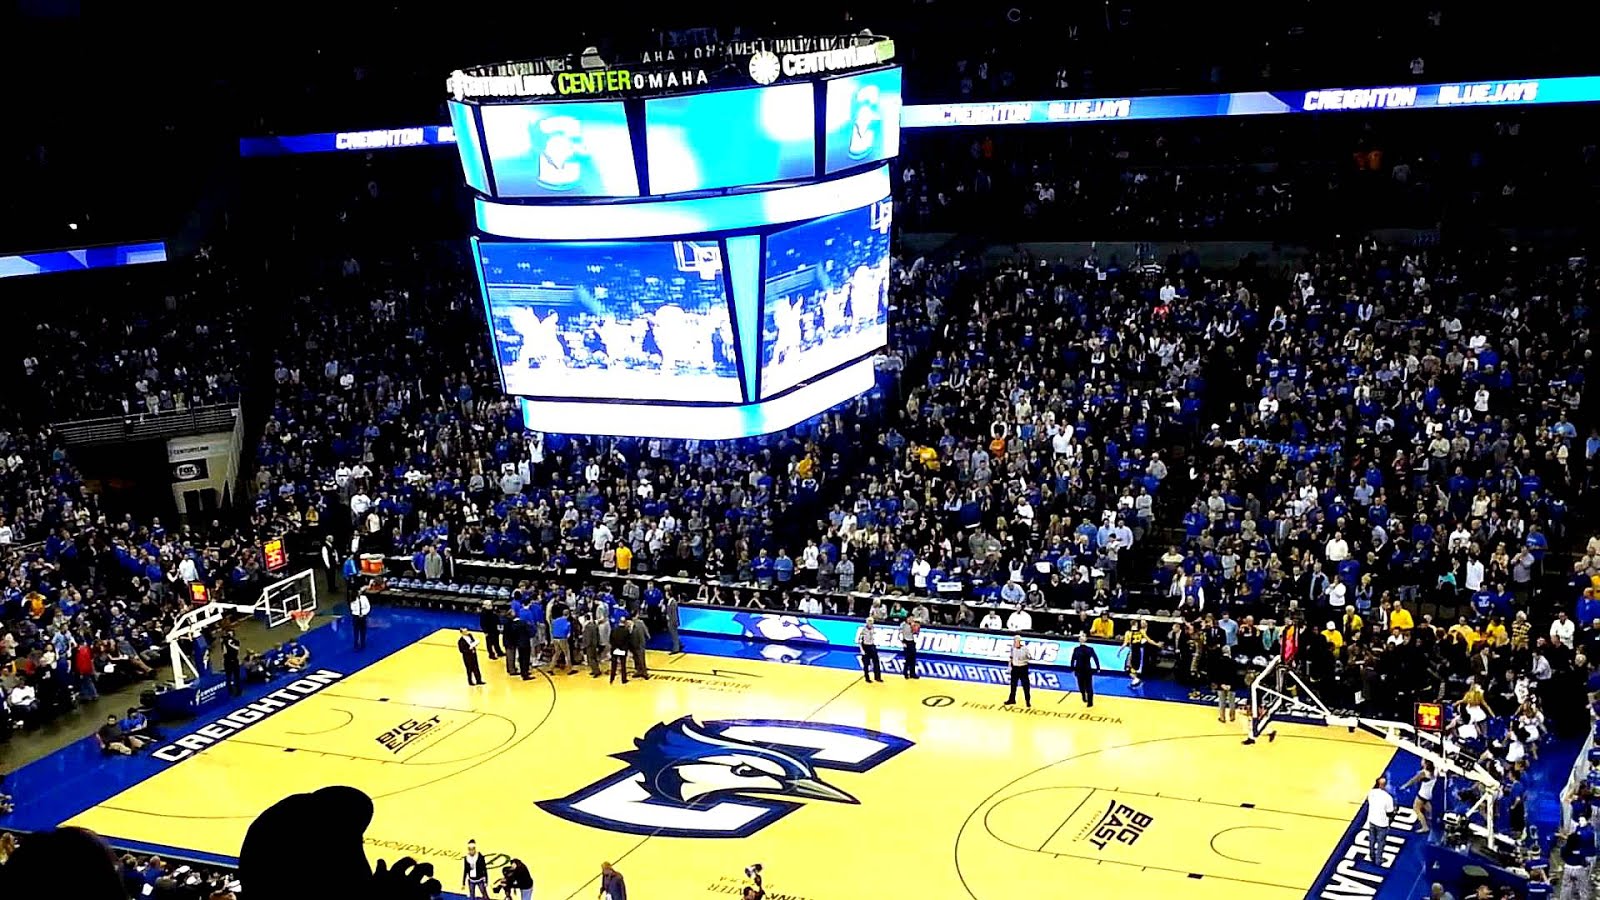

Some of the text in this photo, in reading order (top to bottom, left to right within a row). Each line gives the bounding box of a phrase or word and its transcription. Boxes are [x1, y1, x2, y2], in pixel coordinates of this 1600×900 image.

[558, 70, 630, 94] CENTER
[634, 70, 708, 90] OMAHA
[1303, 82, 1538, 111] CREIGHTON BLUEJAYS
[941, 99, 1131, 125] CREIGHTON BLUEJAYS
[335, 127, 423, 150] CREIGHTON
[152, 669, 343, 762] CREIGHTON
[962, 701, 1123, 724] First National Bank
[376, 719, 418, 744] BIG
[385, 715, 440, 750] EAST
[1090, 804, 1135, 850] EAST
[1116, 812, 1153, 845] BIG
